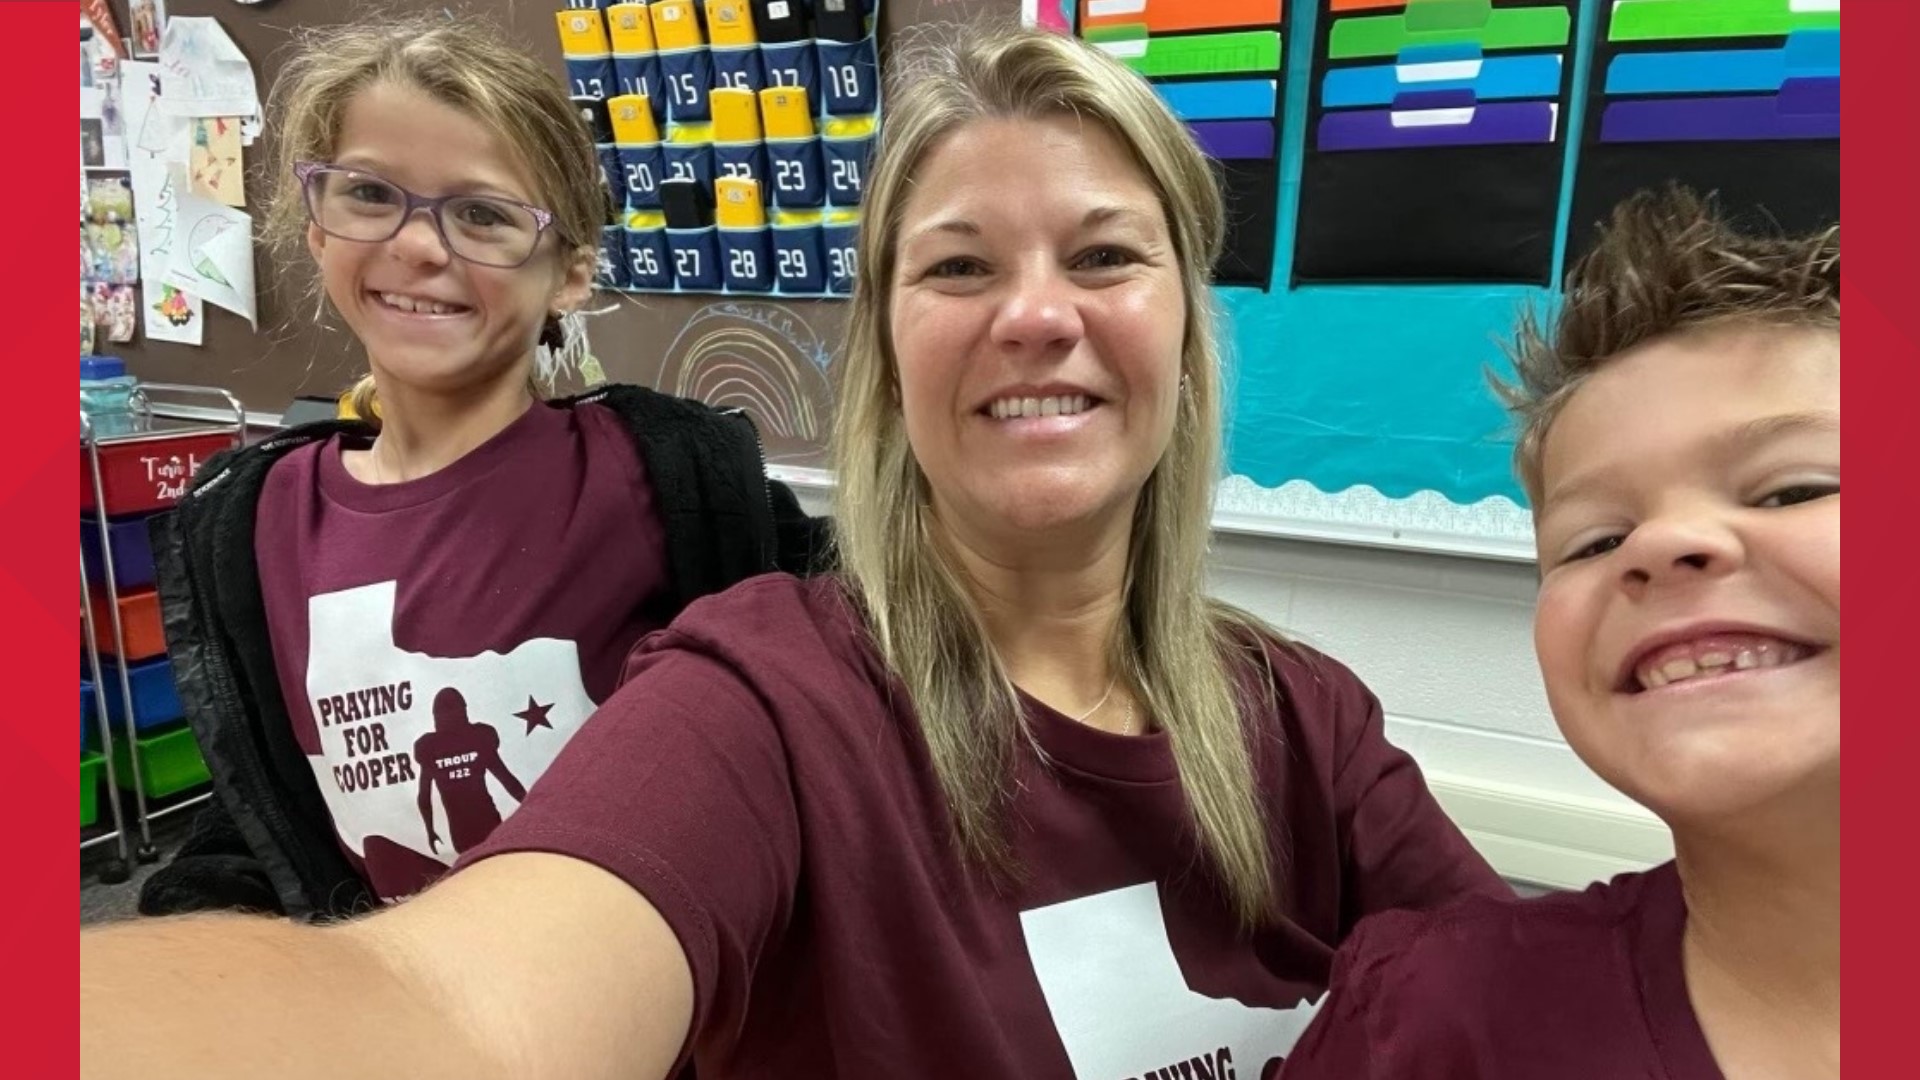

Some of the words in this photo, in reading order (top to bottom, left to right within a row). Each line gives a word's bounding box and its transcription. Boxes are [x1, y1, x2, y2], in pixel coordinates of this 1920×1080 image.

[669, 73, 698, 105] 15
[772, 68, 799, 88] 17
[828, 65, 859, 98] 18
[626, 163, 654, 192] 20
[775, 160, 806, 191] 23
[831, 160, 860, 192] 24
[630, 248, 658, 275] 26
[674, 249, 699, 277] 27
[729, 249, 757, 278] 28
[777, 249, 807, 278] 29
[829, 247, 858, 278] 30
[157, 478, 185, 499] 2nd
[317, 680, 412, 727] PRAYING
[343, 722, 389, 758] FOR
[333, 752, 415, 793] COOPER
[435, 751, 478, 769] TROUP
